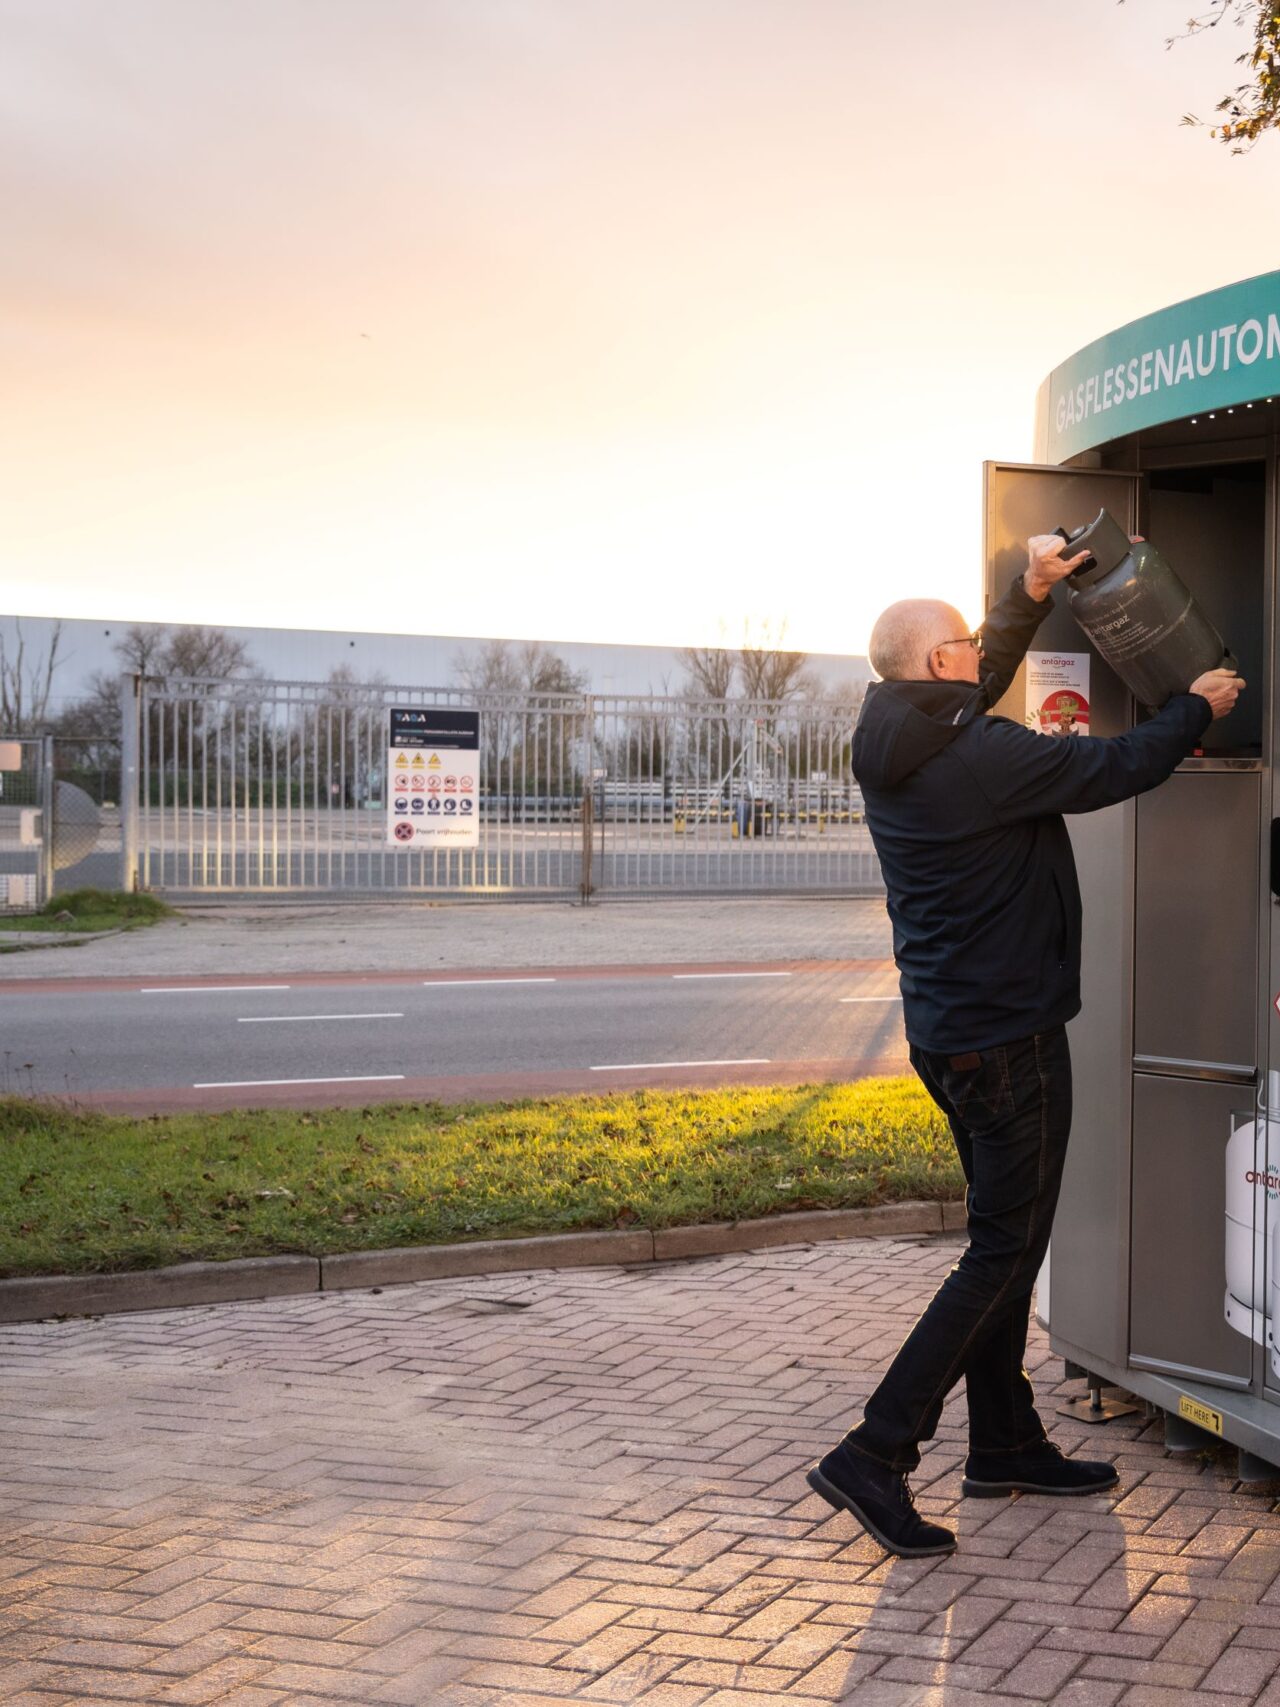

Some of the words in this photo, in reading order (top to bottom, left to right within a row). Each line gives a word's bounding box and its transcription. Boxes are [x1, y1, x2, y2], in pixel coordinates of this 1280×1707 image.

[1041, 658, 1076, 667] antargaz
[1180, 1401, 1194, 1416] LIFT
[1193, 1408, 1210, 1425] HERE
